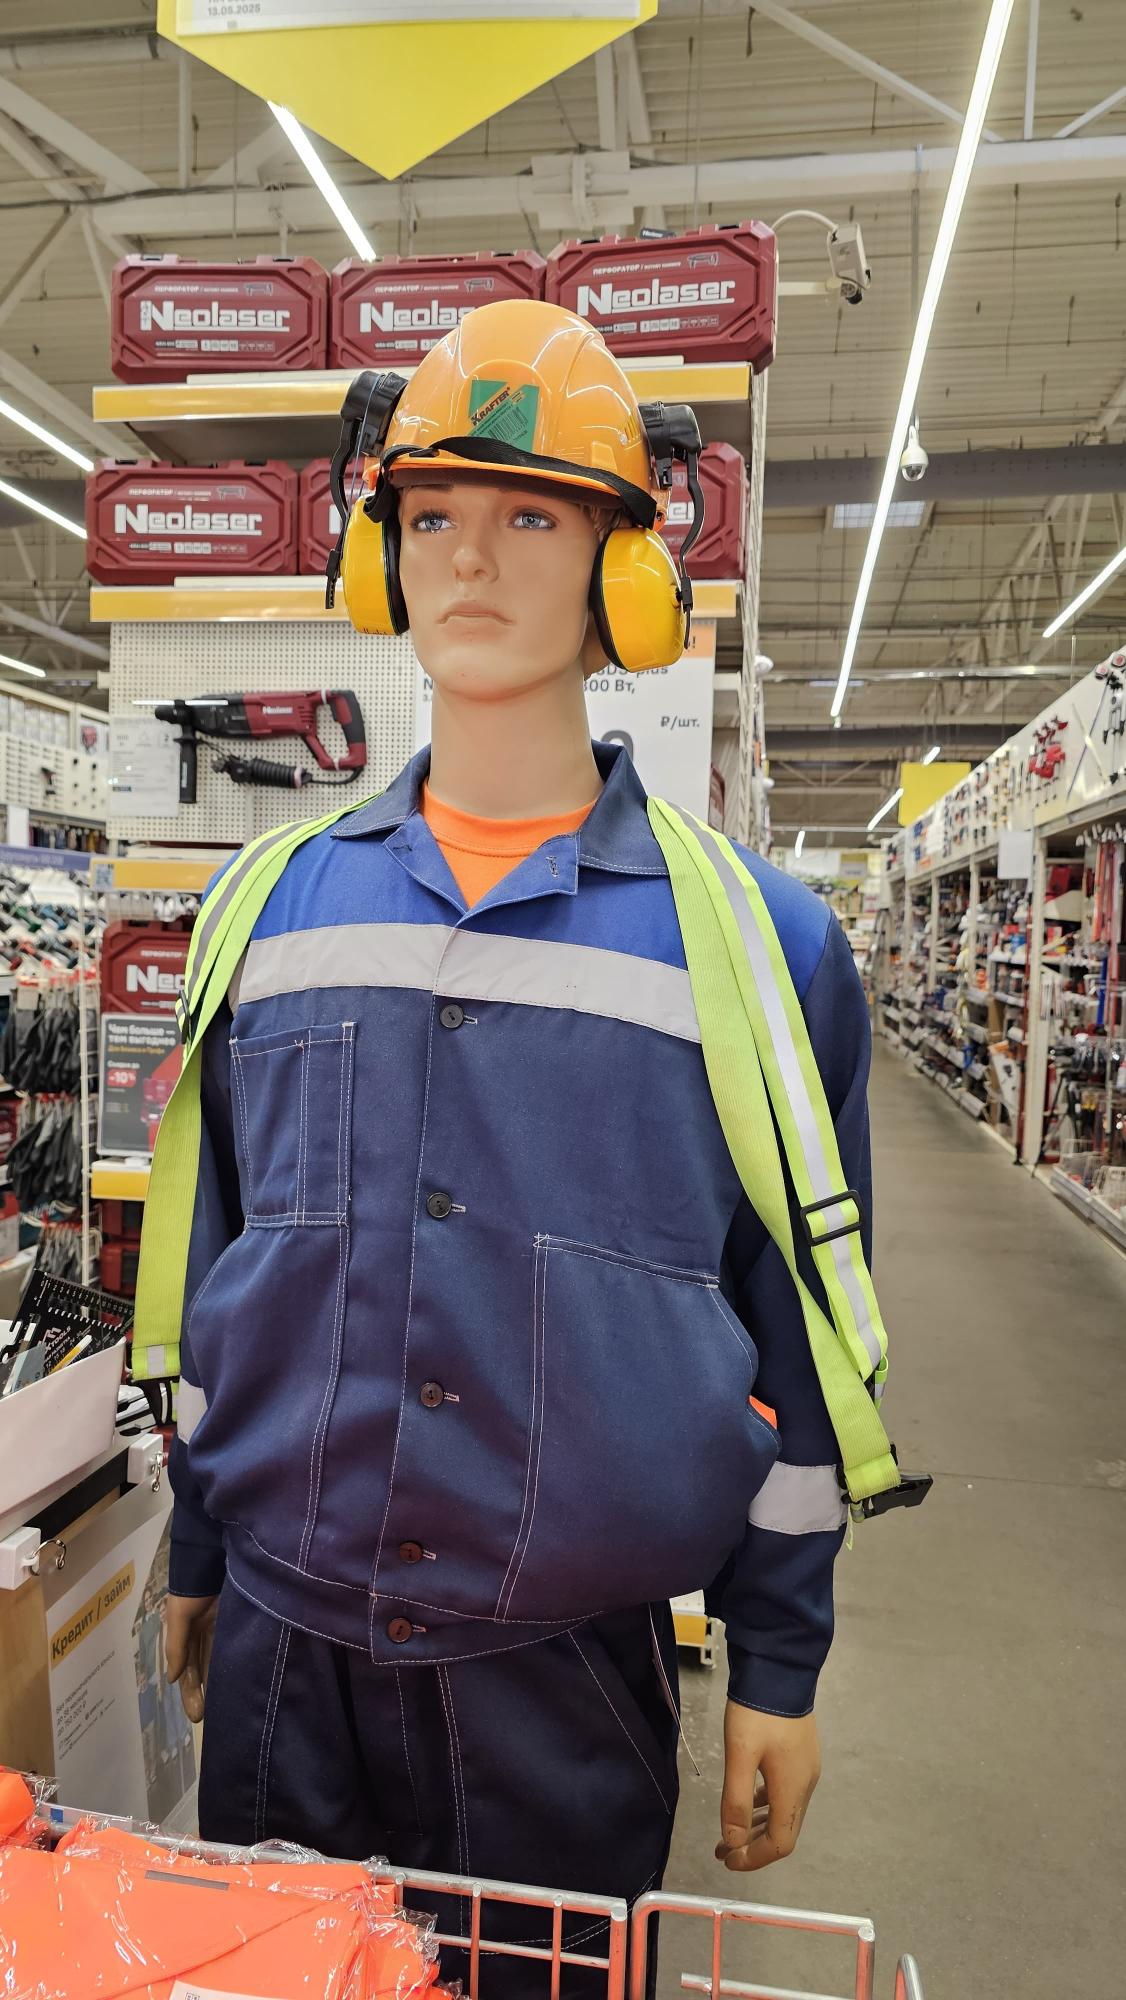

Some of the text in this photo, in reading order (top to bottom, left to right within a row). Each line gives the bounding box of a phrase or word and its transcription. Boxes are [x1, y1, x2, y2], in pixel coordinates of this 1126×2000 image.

[592, 264, 641, 275] ПЕРФОРАТОР
[577, 278, 736, 316] Neolaser
[140, 300, 290, 332] Neolaser
[115, 504, 262, 536] Neolaser
[615, 680, 635, 694] Вт,
[52, 1610, 94, 1659] Кредит
[104, 1574, 131, 1607] займ
